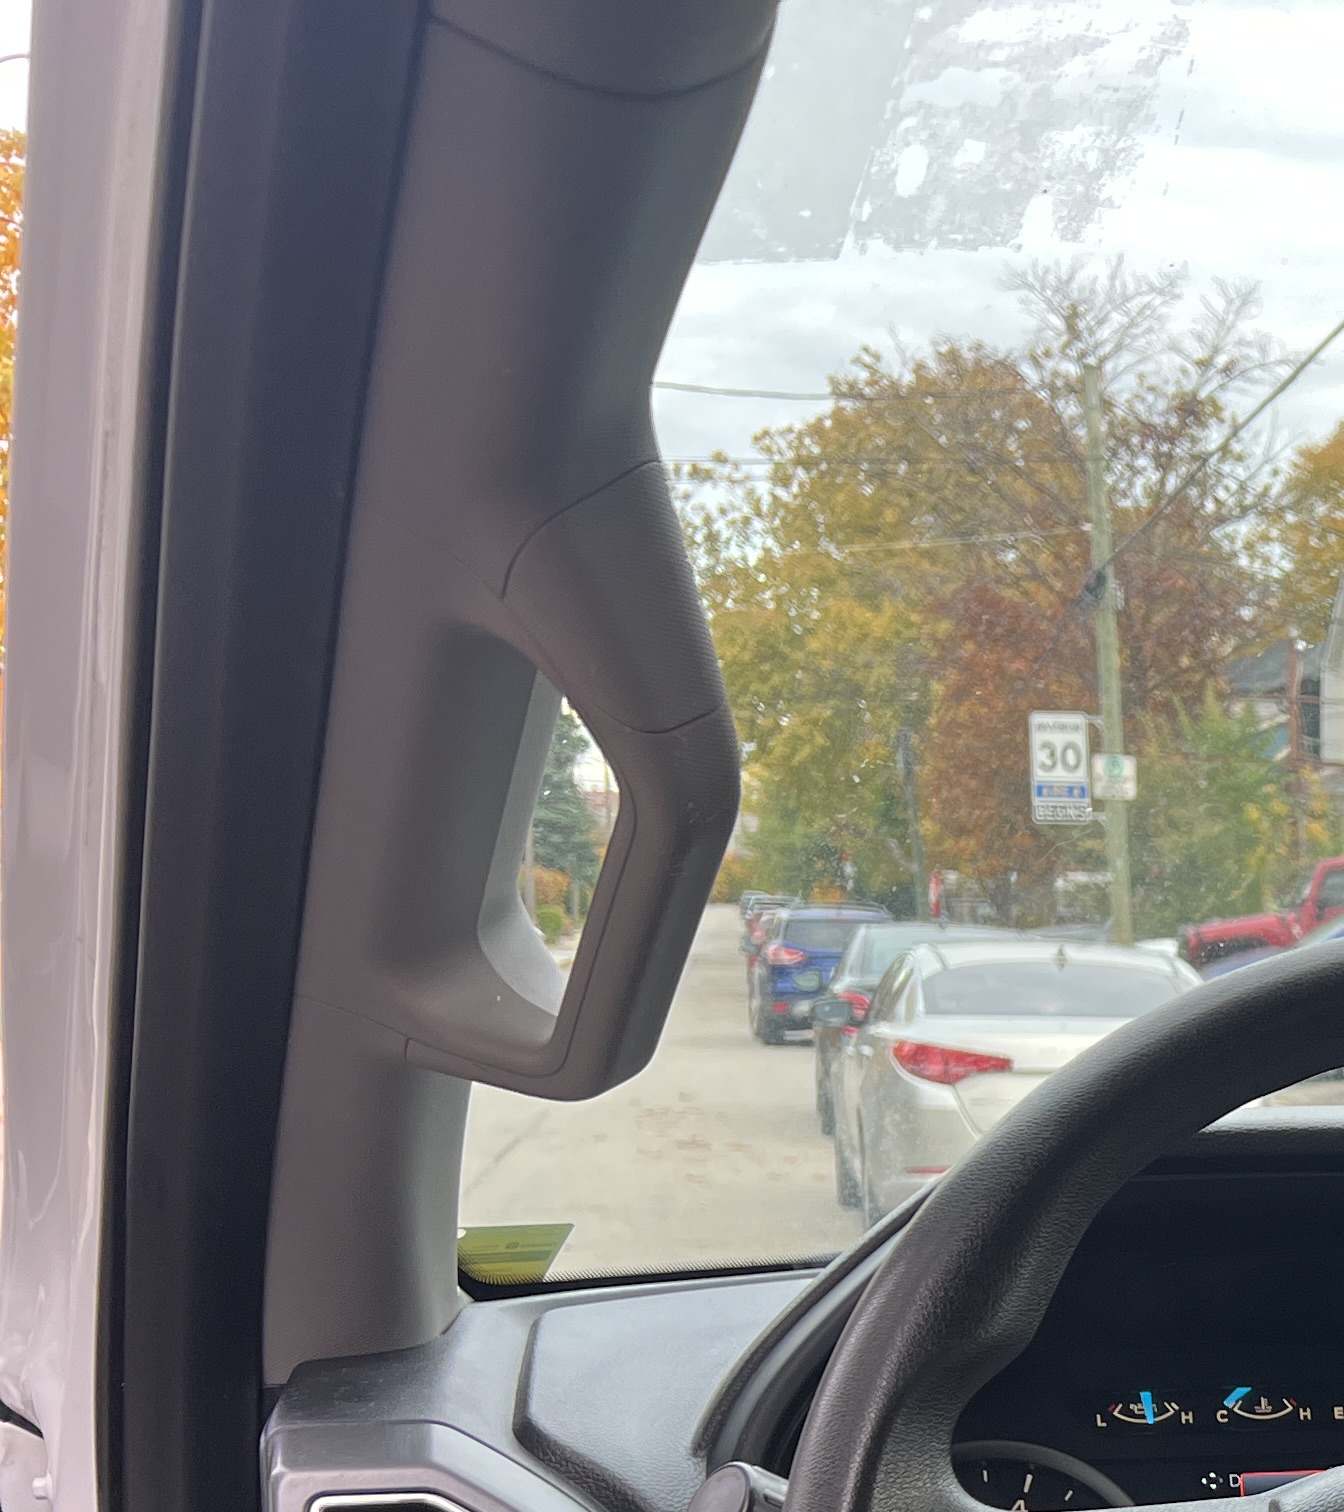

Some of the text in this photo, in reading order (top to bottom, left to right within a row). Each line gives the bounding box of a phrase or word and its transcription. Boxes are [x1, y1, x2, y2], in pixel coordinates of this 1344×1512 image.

[1037, 740, 1084, 774] 30
[1096, 1411, 1194, 1427] L H
[1216, 1407, 1312, 1423] C H
[1333, 1406, 1344, 1420] E
[1229, 1473, 1241, 1488] D
